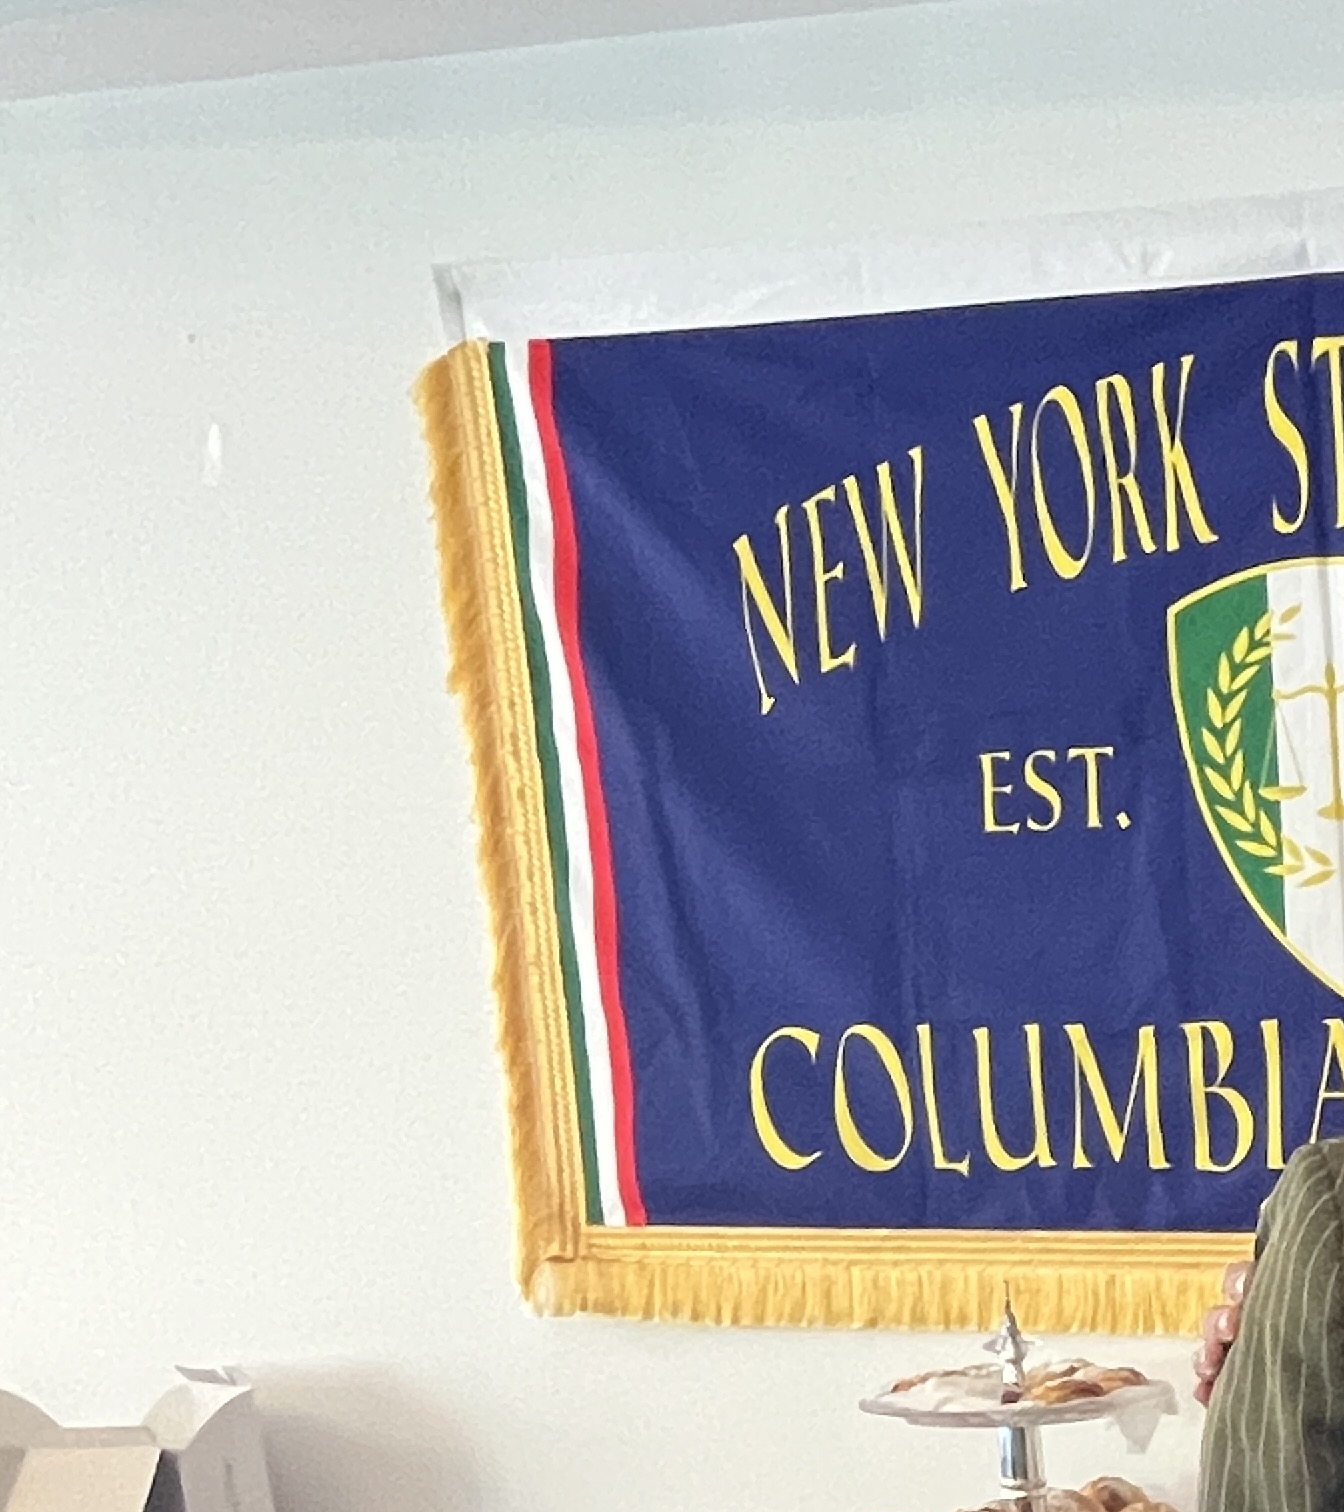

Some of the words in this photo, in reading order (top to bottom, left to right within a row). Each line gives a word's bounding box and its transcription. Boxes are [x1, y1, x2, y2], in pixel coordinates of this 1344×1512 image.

[733, 447, 925, 714] NEW
[974, 355, 1218, 593] YORK
[980, 746, 1132, 833] EST.
